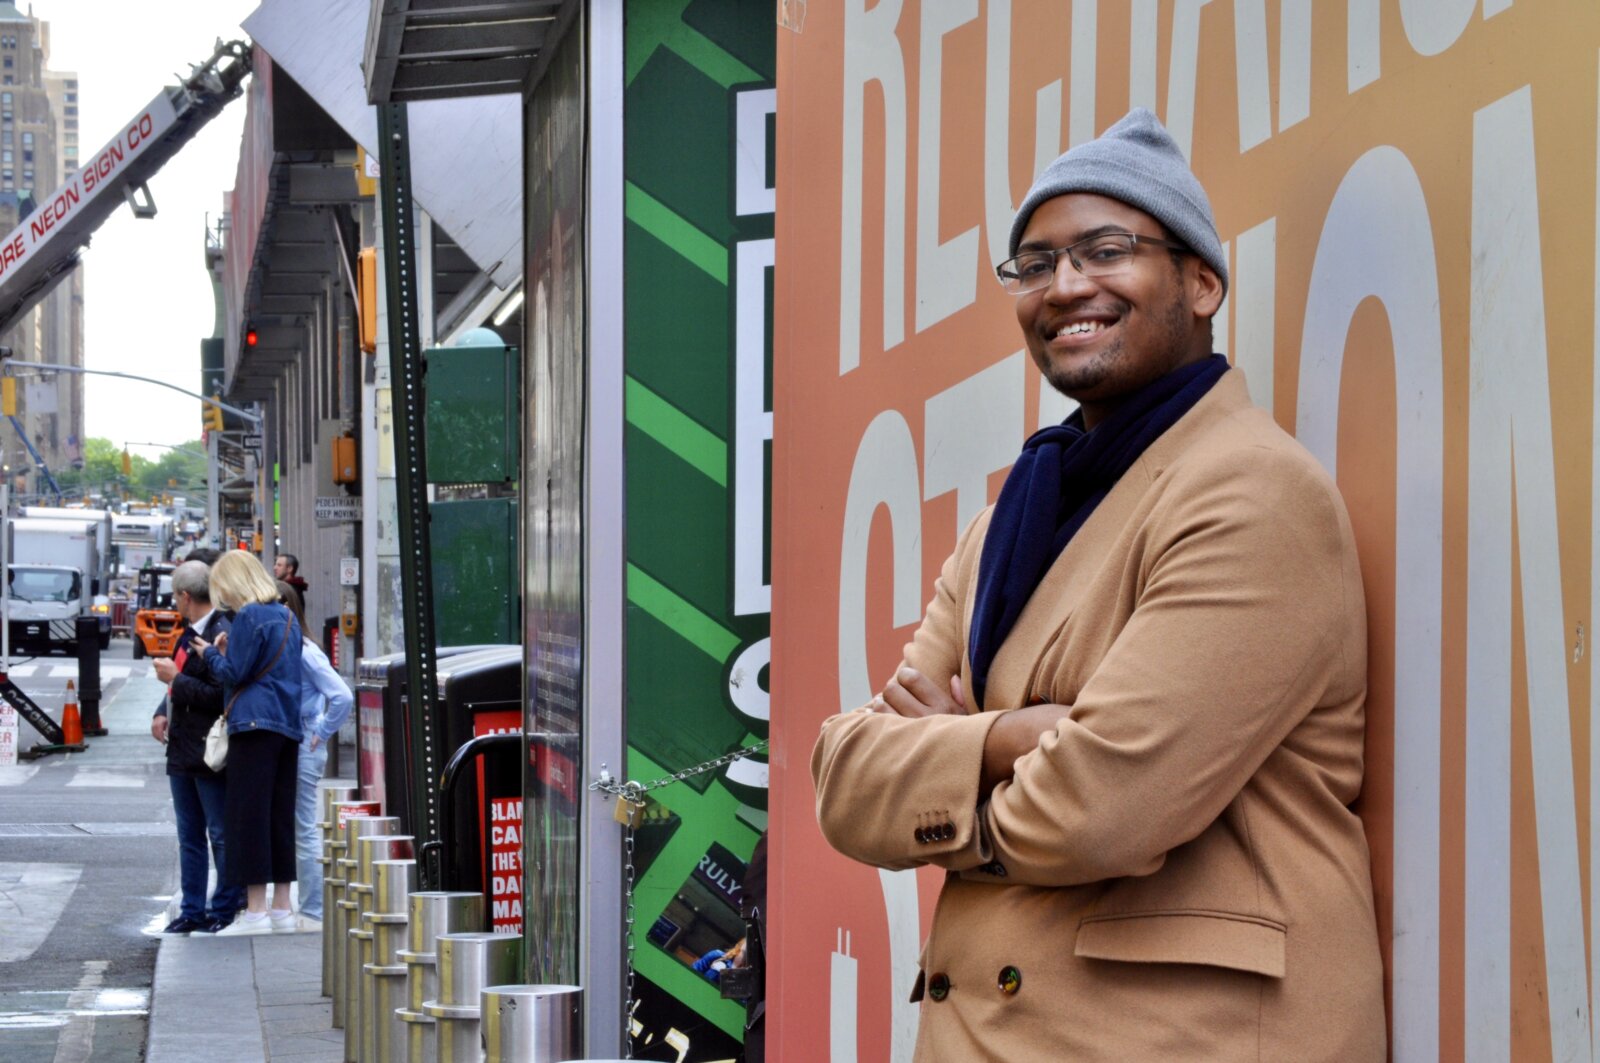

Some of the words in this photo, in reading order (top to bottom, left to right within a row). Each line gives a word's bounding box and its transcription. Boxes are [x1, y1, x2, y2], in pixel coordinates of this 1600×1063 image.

[30, 182, 80, 243] NEON
[83, 139, 124, 193] SIGN
[127, 112, 152, 150] CO
[315, 510, 331, 519] KEEP
[333, 509, 358, 519] MOVING
[492, 825, 523, 845] CA
[492, 875, 523, 895] DA
